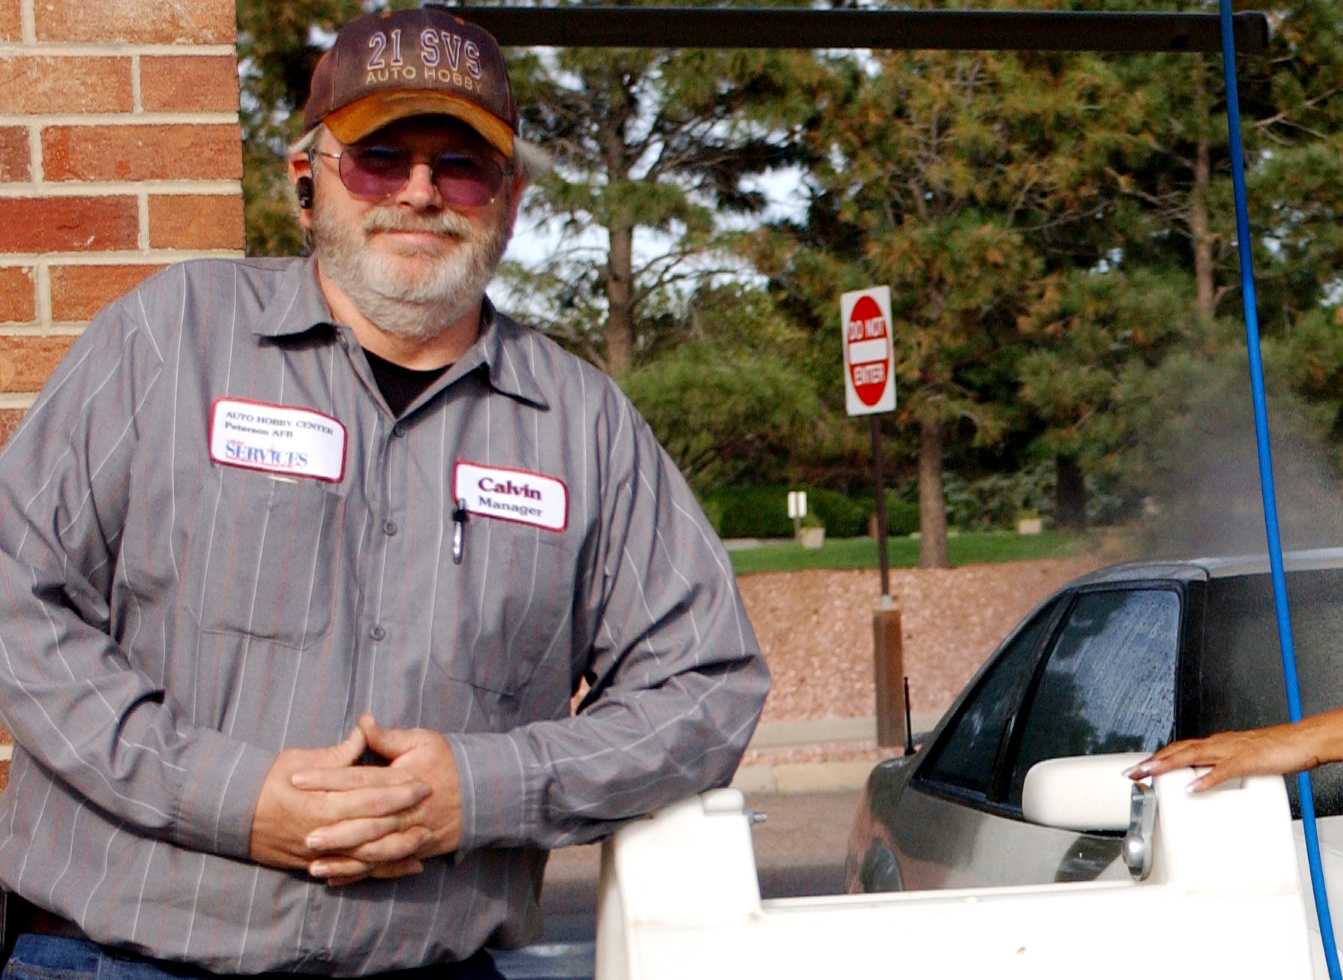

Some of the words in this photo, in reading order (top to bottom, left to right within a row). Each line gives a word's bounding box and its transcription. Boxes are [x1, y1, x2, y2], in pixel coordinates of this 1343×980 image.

[367, 29, 403, 70] 21
[420, 28, 482, 80] SVS
[366, 66, 416, 85] AUTO
[424, 66, 483, 94] HOBBY
[848, 320, 864, 340] DO
[865, 316, 885, 338] NOT
[853, 363, 886, 386] ENTER
[225, 422, 269, 436] Peterson
[272, 429, 294, 438] AFB
[226, 411, 254, 423] AUTO
[257, 416, 293, 427] HOBBY
[296, 420, 333, 435] CENTER
[225, 443, 308, 467] SERVICES
[478, 477, 541, 500] Calvin
[479, 496, 543, 516] Manager
